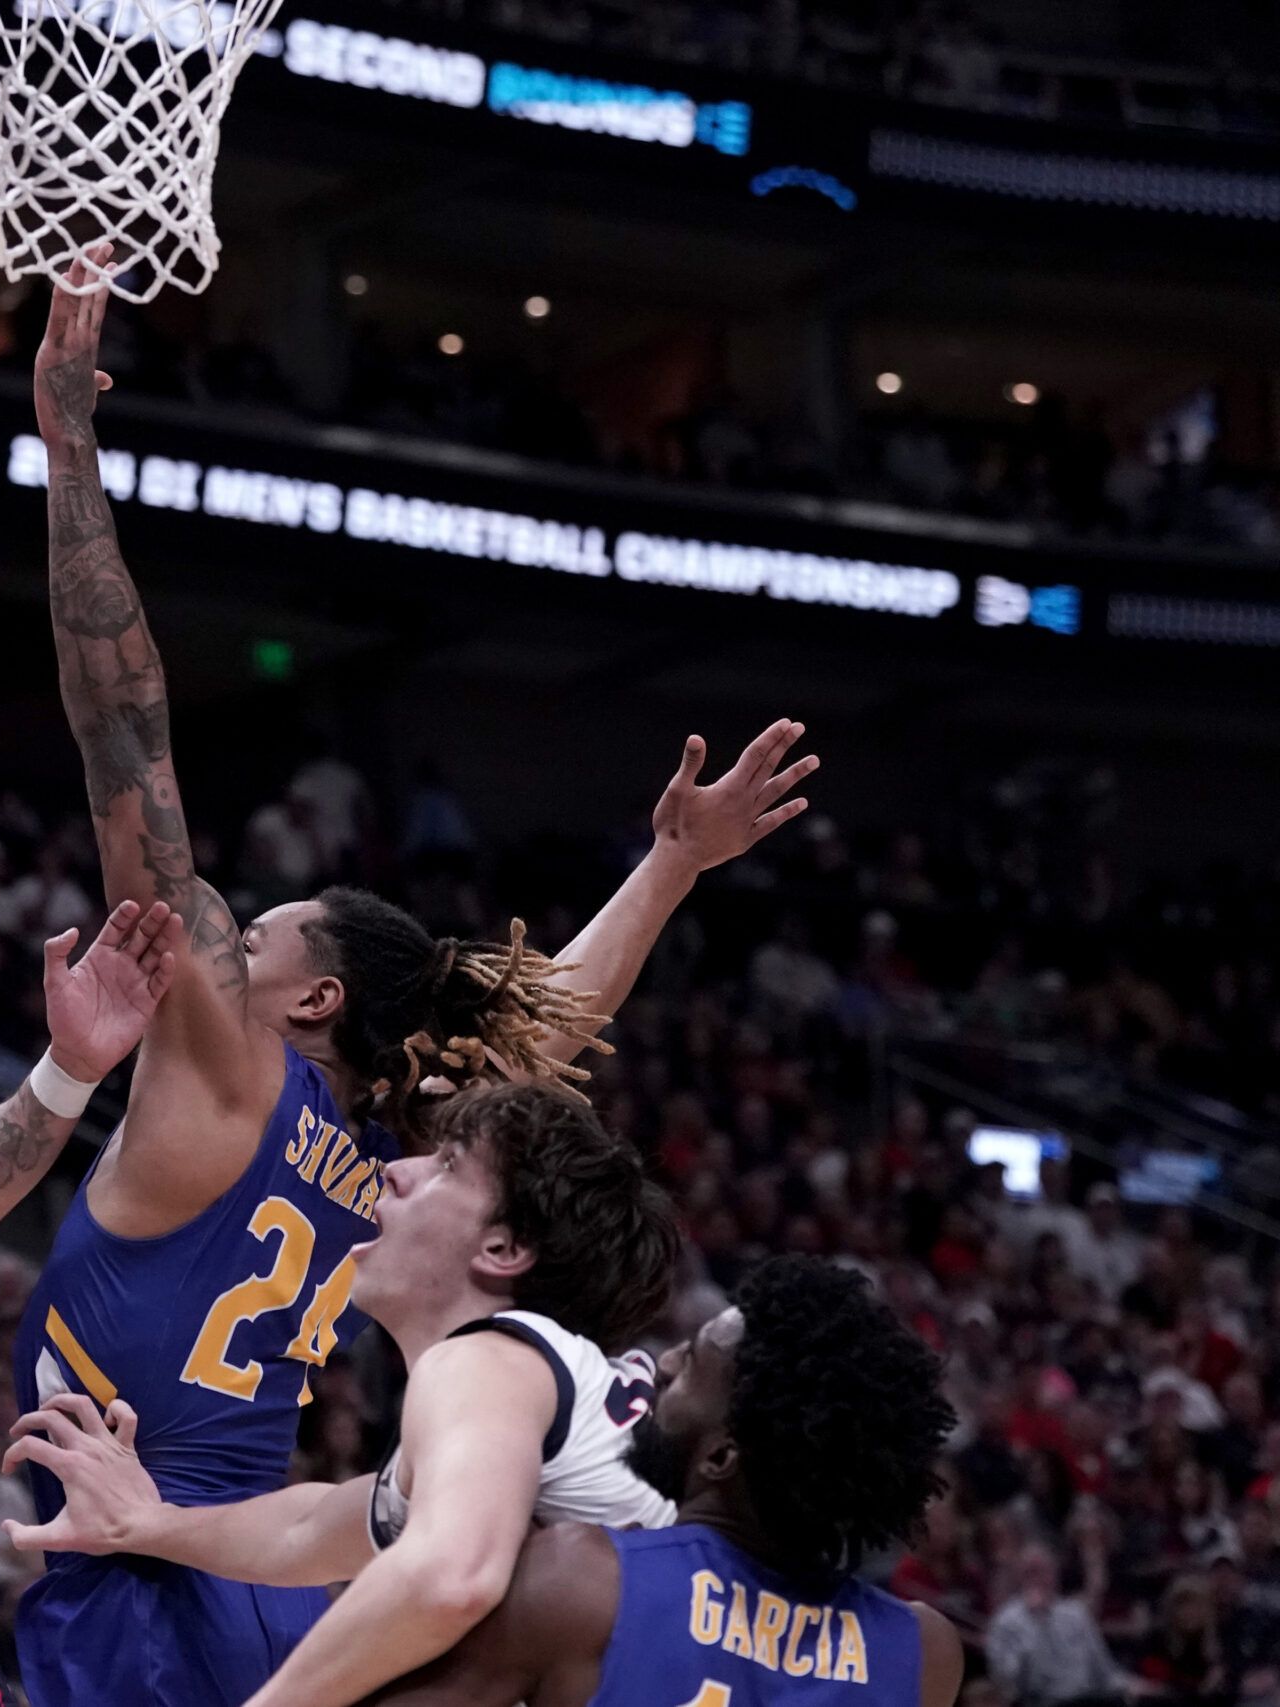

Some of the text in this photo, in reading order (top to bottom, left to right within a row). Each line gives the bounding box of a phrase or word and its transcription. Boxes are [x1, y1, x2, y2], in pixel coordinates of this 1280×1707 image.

[203, 465, 342, 534] MEN'S
[344, 489, 612, 578] BASKETBALL
[615, 531, 960, 618] CHAMPIONSHIP
[689, 1569, 869, 1685] GARCIA
